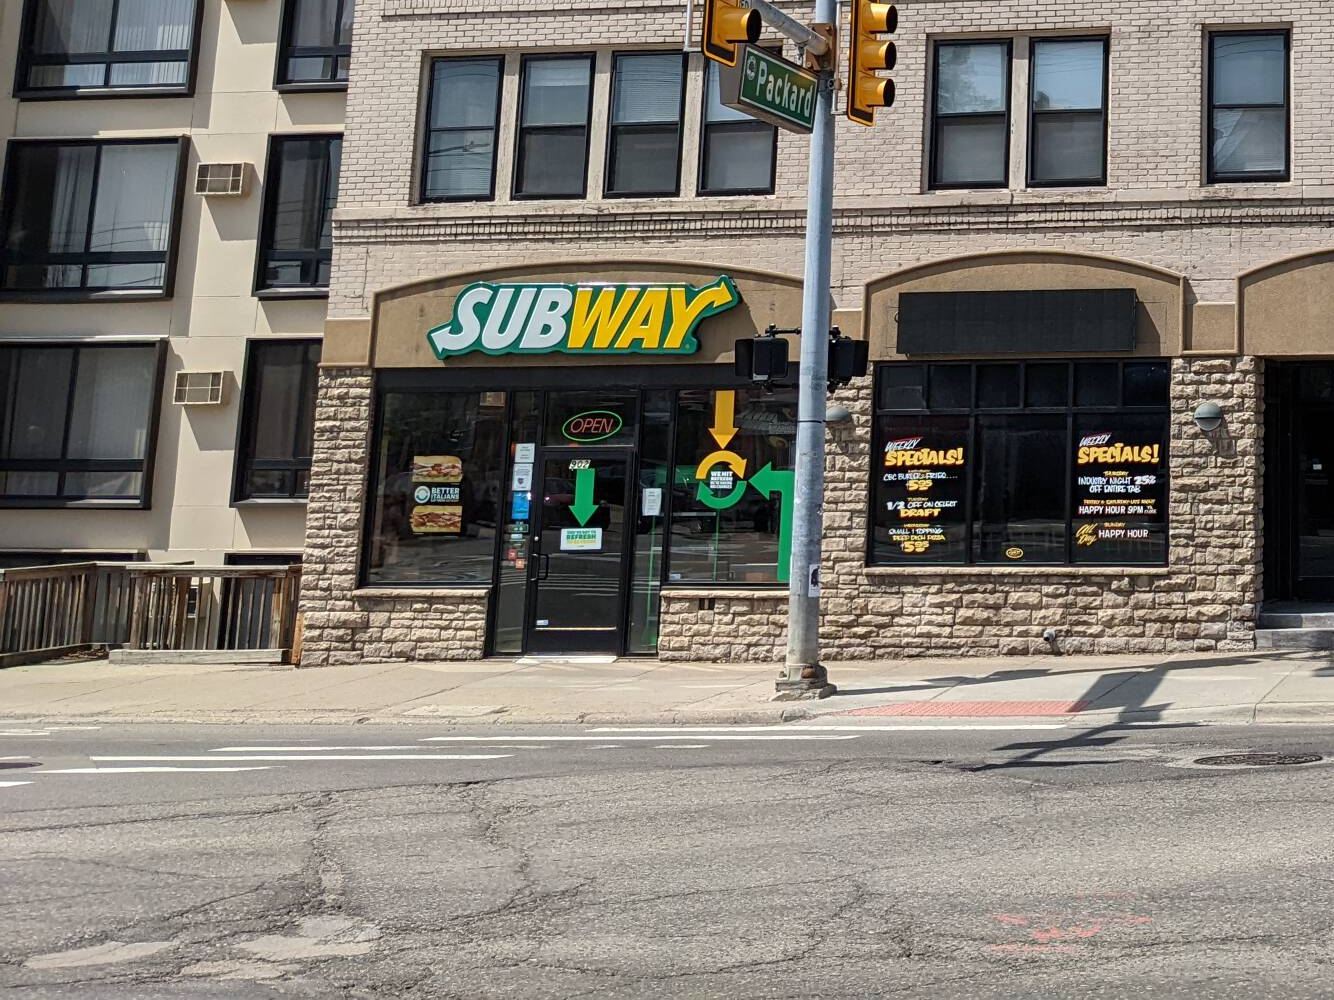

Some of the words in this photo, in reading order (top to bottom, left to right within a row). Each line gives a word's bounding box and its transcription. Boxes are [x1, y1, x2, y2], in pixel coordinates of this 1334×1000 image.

[756, 61, 814, 118] Packard
[430, 281, 733, 354] SUBWAY
[570, 418, 613, 433] OPEN
[884, 439, 921, 452] WEEKLY
[1079, 434, 1111, 448] WEEKLY
[884, 447, 964, 467] SPECIALS!
[1077, 442, 1160, 464] SPECIALS!
[570, 460, 590, 470] 902
[883, 473, 897, 481] CBC
[1078, 476, 1109, 485] INDUSTRY
[1109, 476, 1132, 485] NIGHT
[1134, 475, 1157, 485] 25%
[1089, 485, 1103, 493] OFF
[1103, 485, 1127, 493] ENTIRE
[1127, 485, 1142, 493] TAB
[886, 501, 905, 510] 1/2
[1078, 505, 1105, 514] HAPPY
[1105, 505, 1126, 514] HOUR
[1127, 505, 1144, 514] 9PM
[900, 508, 941, 518] DRAFT
[1098, 529, 1125, 538] HAPPY
[1127, 529, 1149, 538] HOUR
